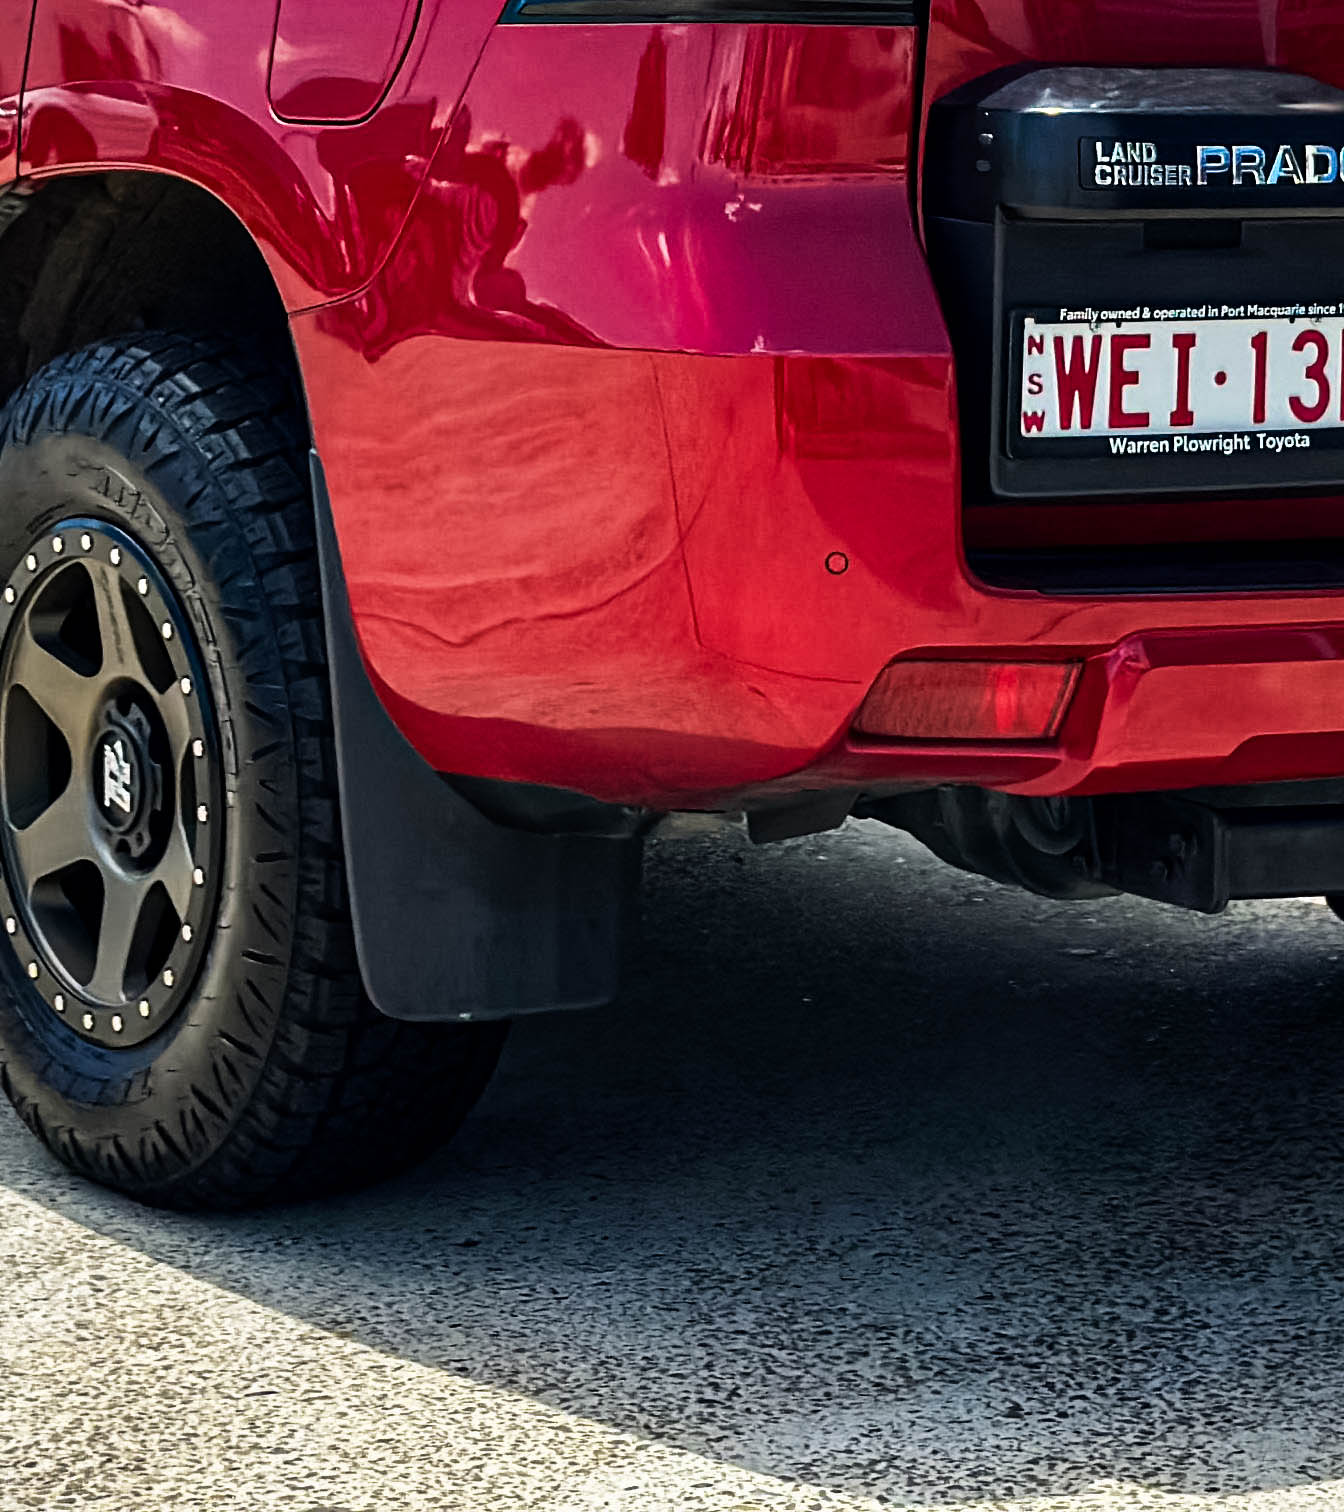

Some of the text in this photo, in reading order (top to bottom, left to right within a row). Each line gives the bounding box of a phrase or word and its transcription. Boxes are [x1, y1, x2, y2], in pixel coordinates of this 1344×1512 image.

[1094, 141, 1157, 163] LAND
[1094, 163, 1192, 187] CRUISER
[1059, 307, 1099, 323] Family
[1100, 306, 1141, 320] owned
[1142, 306, 1152, 319] &
[1153, 305, 1206, 321] operated
[1207, 304, 1219, 318] in
[1221, 304, 1245, 317] Port
[1247, 303, 1306, 319] Macquarie
[1308, 302, 1336, 316] since
[1109, 432, 1311, 455] Warren Plowright Toyota
